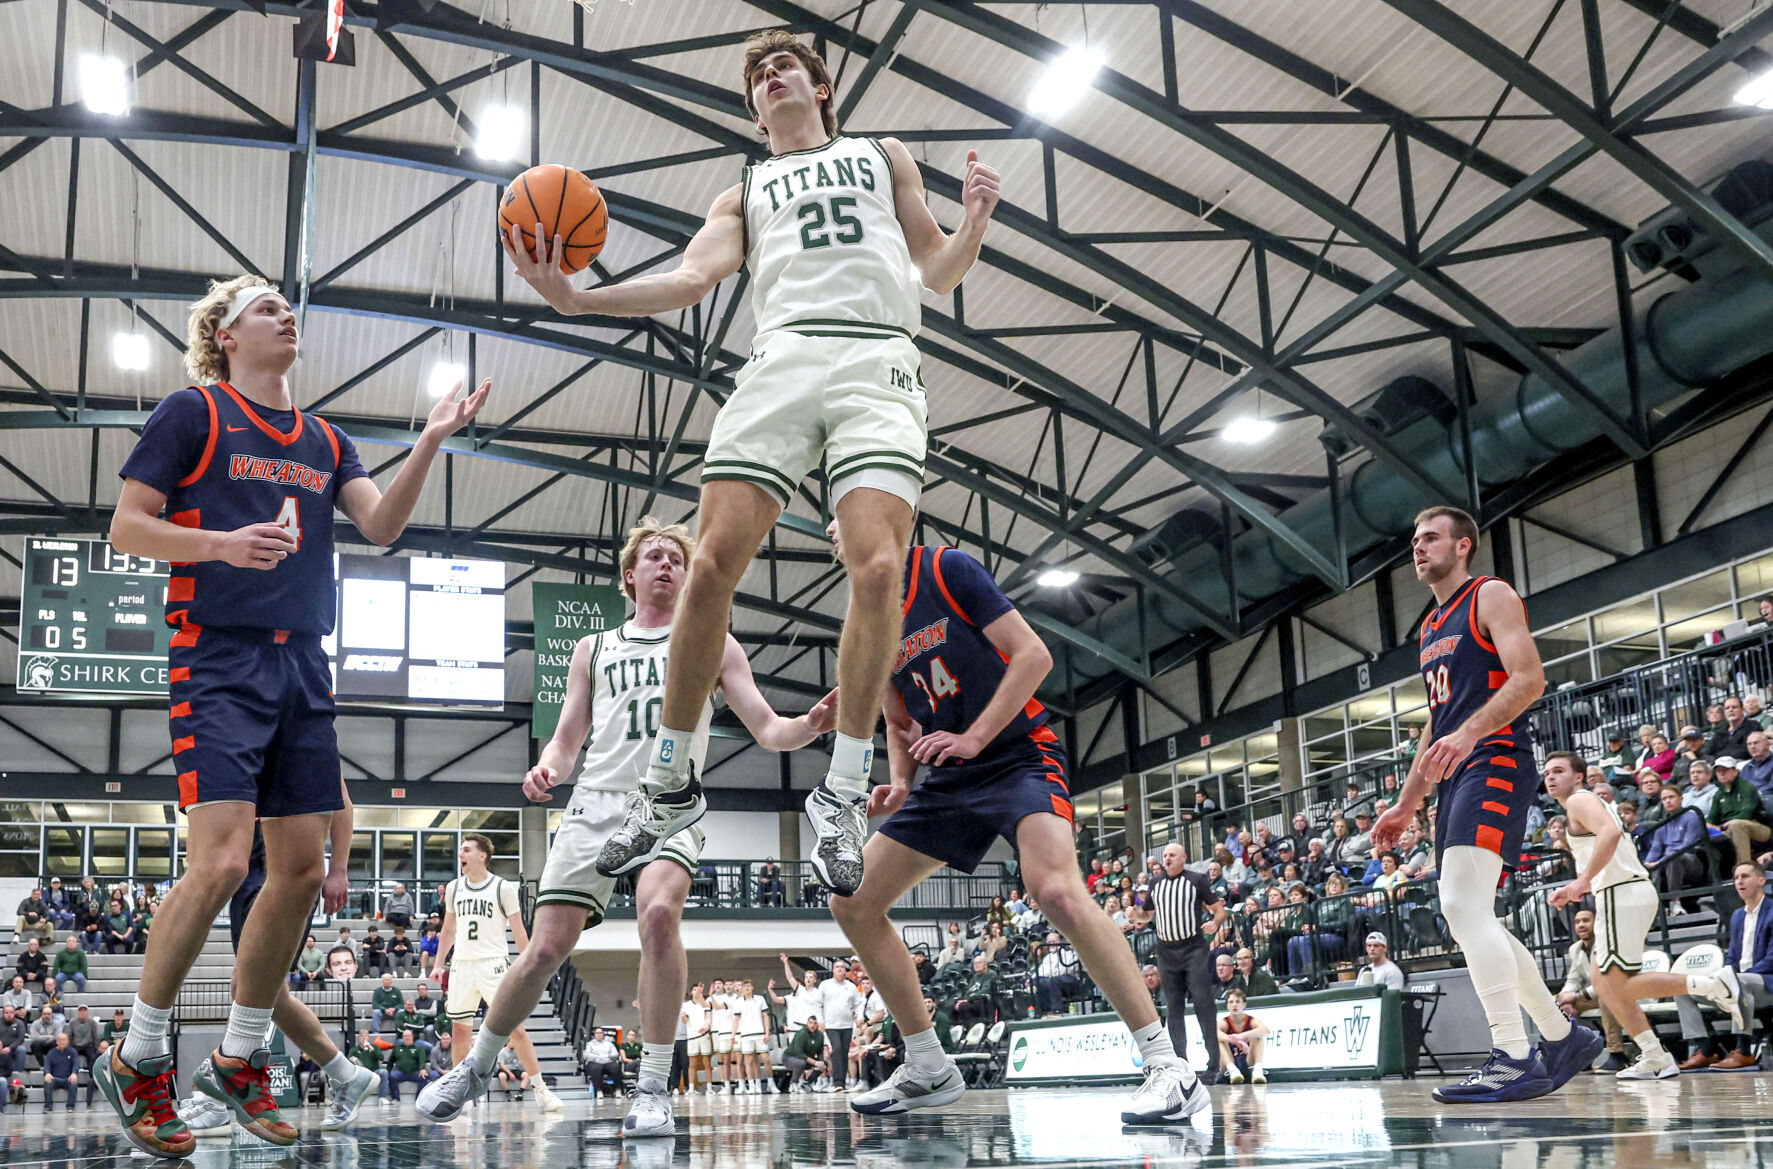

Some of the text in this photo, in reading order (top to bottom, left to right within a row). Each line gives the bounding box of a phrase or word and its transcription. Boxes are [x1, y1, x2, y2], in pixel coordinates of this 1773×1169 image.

[763, 157, 875, 213] TITANS
[797, 197, 864, 250] 25
[891, 367, 914, 392] IWU
[229, 454, 332, 494] WHEATON
[275, 496, 303, 551] 4
[52, 557, 79, 587] 13
[118, 595, 145, 604] period
[557, 601, 602, 615] NCAA
[555, 615, 605, 630] DIV. III
[45, 626, 61, 648] 0
[60, 664, 131, 684] SHIRK
[604, 656, 668, 698] TITA
[1359, 667, 1369, 686] C
[1426, 664, 1452, 710] 20
[626, 697, 662, 740] 10
[456, 898, 495, 919] TITANS
[467, 920, 479, 941] 2
[1686, 954, 1713, 965] TITANS
[1411, 984, 1435, 994] TITANS
[1289, 1026, 1338, 1047] TITANS
